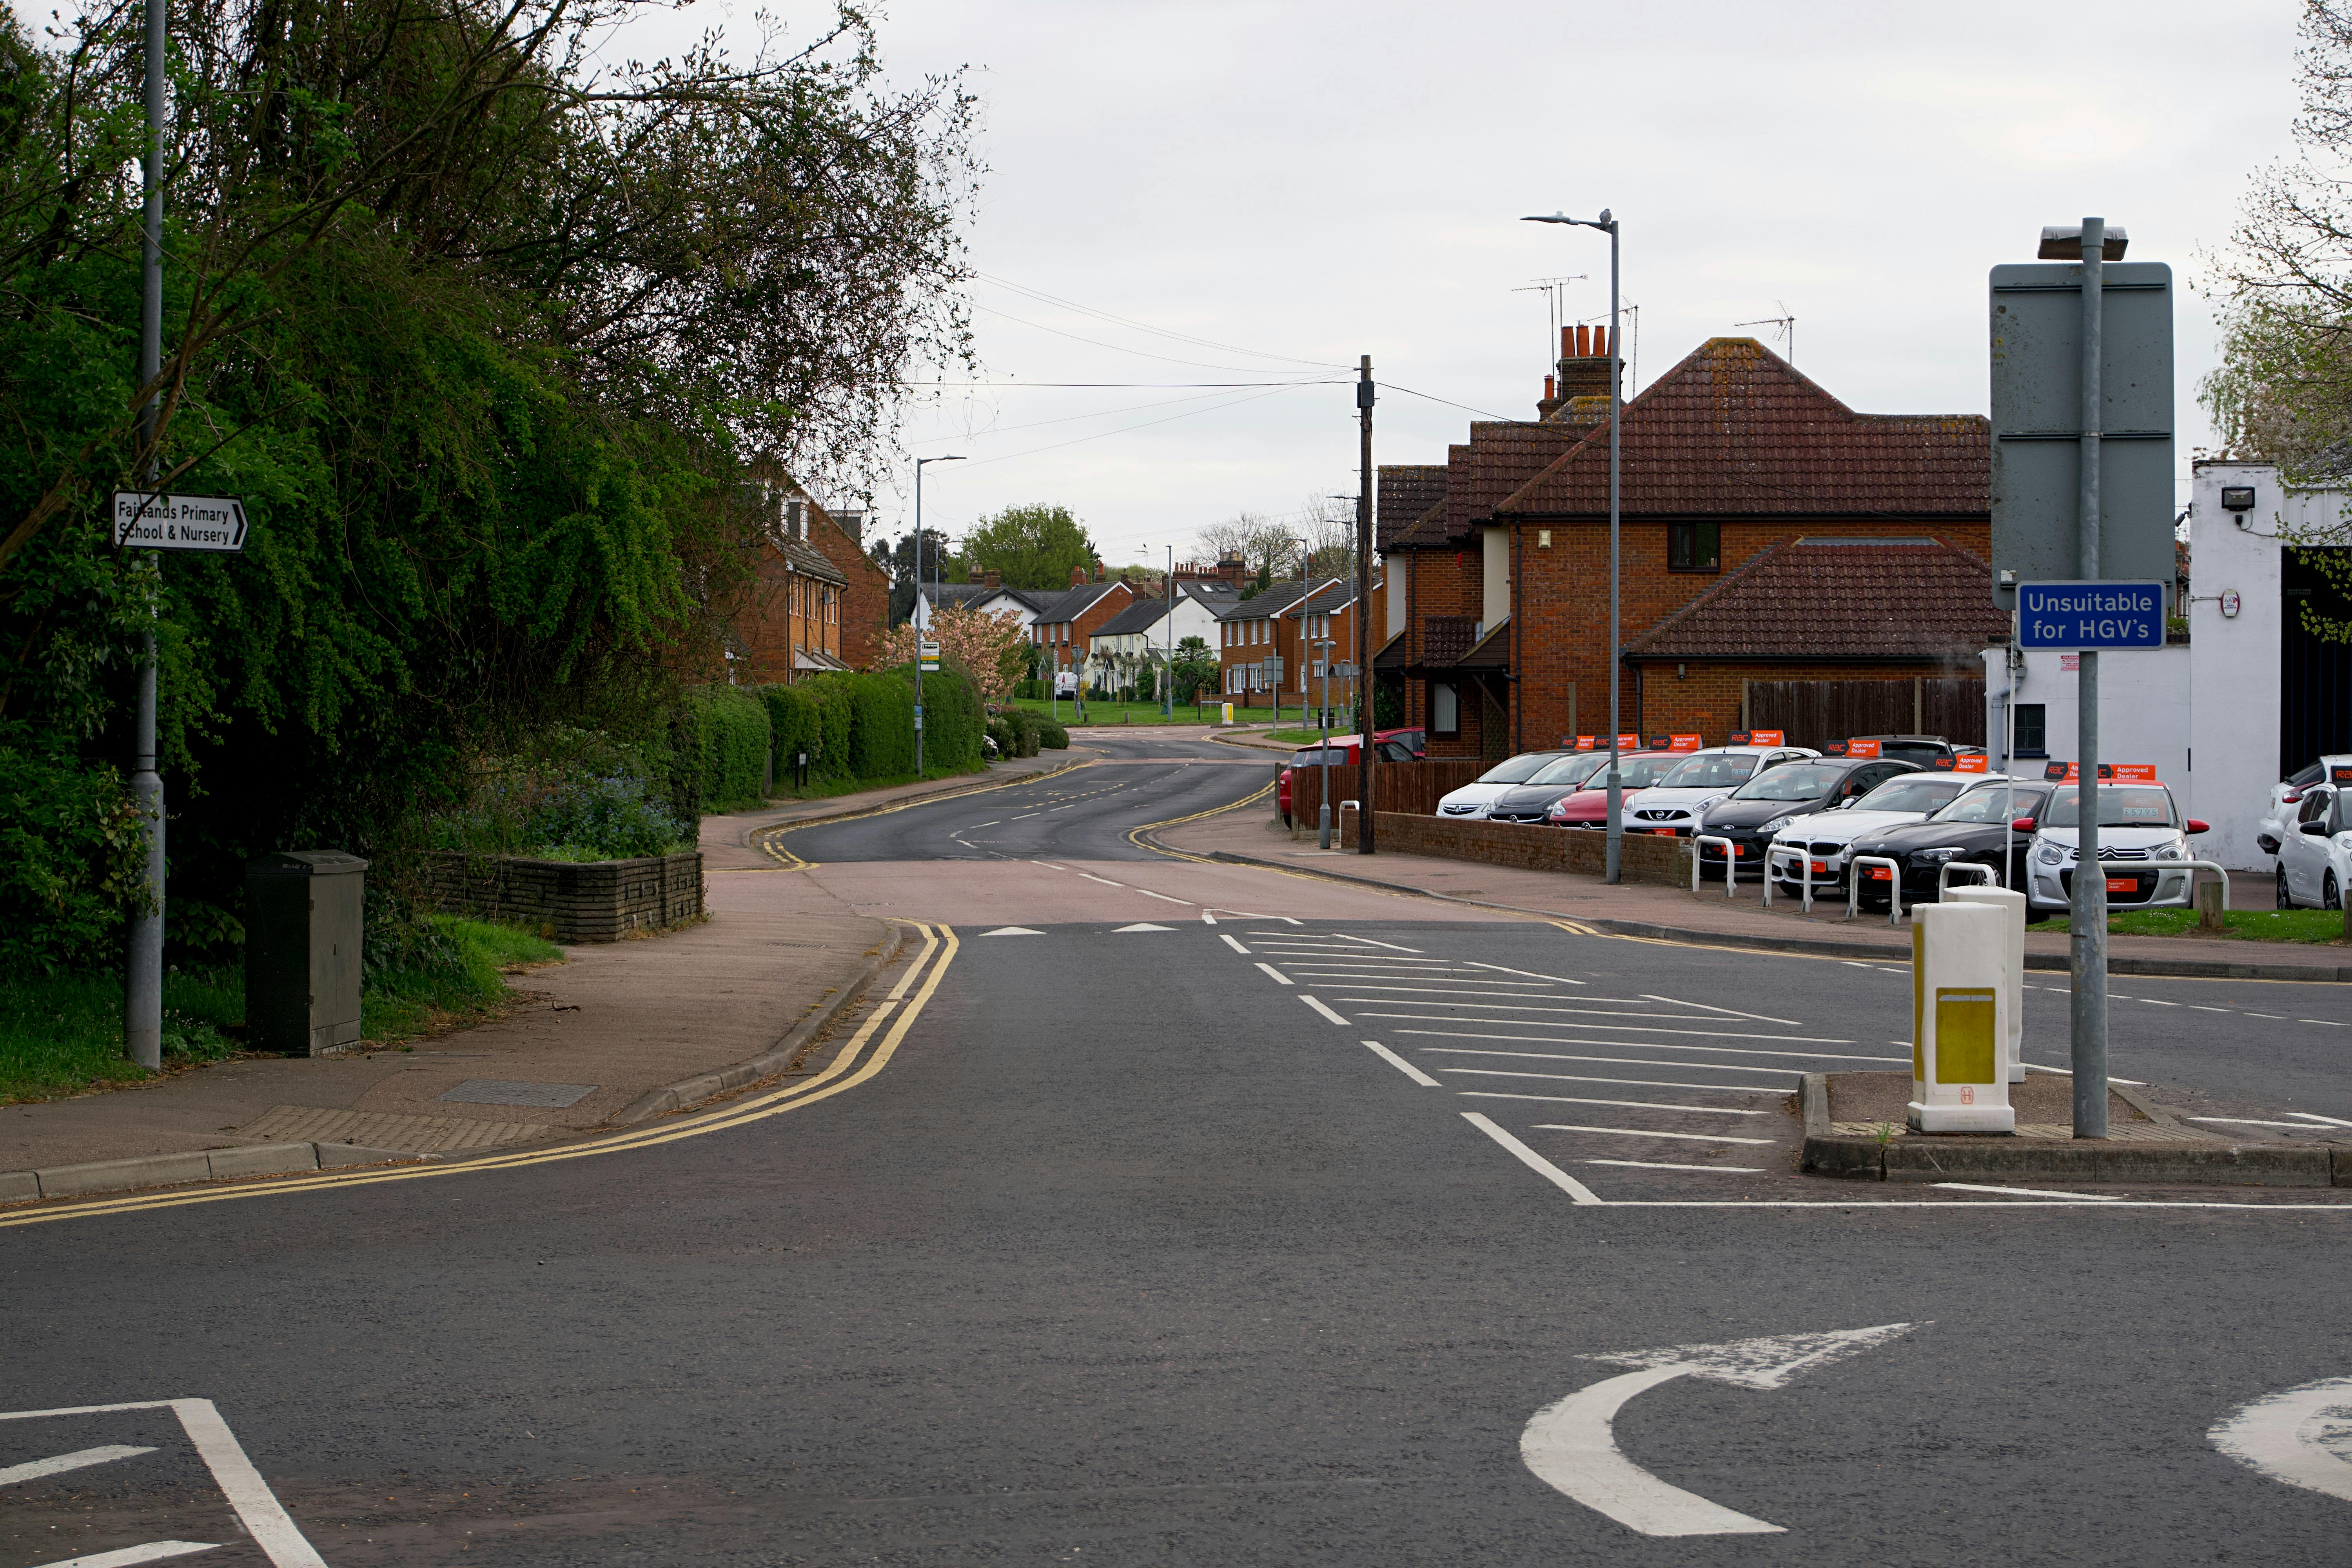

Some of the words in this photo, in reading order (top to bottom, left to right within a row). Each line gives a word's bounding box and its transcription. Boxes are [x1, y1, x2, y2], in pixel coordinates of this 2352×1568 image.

[182, 505, 229, 524] Primary
[119, 523, 163, 539] School
[168, 525, 176, 540] &
[181, 526, 229, 545] Nursery
[2029, 592, 2152, 612] Unsuitable
[2033, 620, 2066, 639] for
[2080, 619, 2149, 639] HGV's
